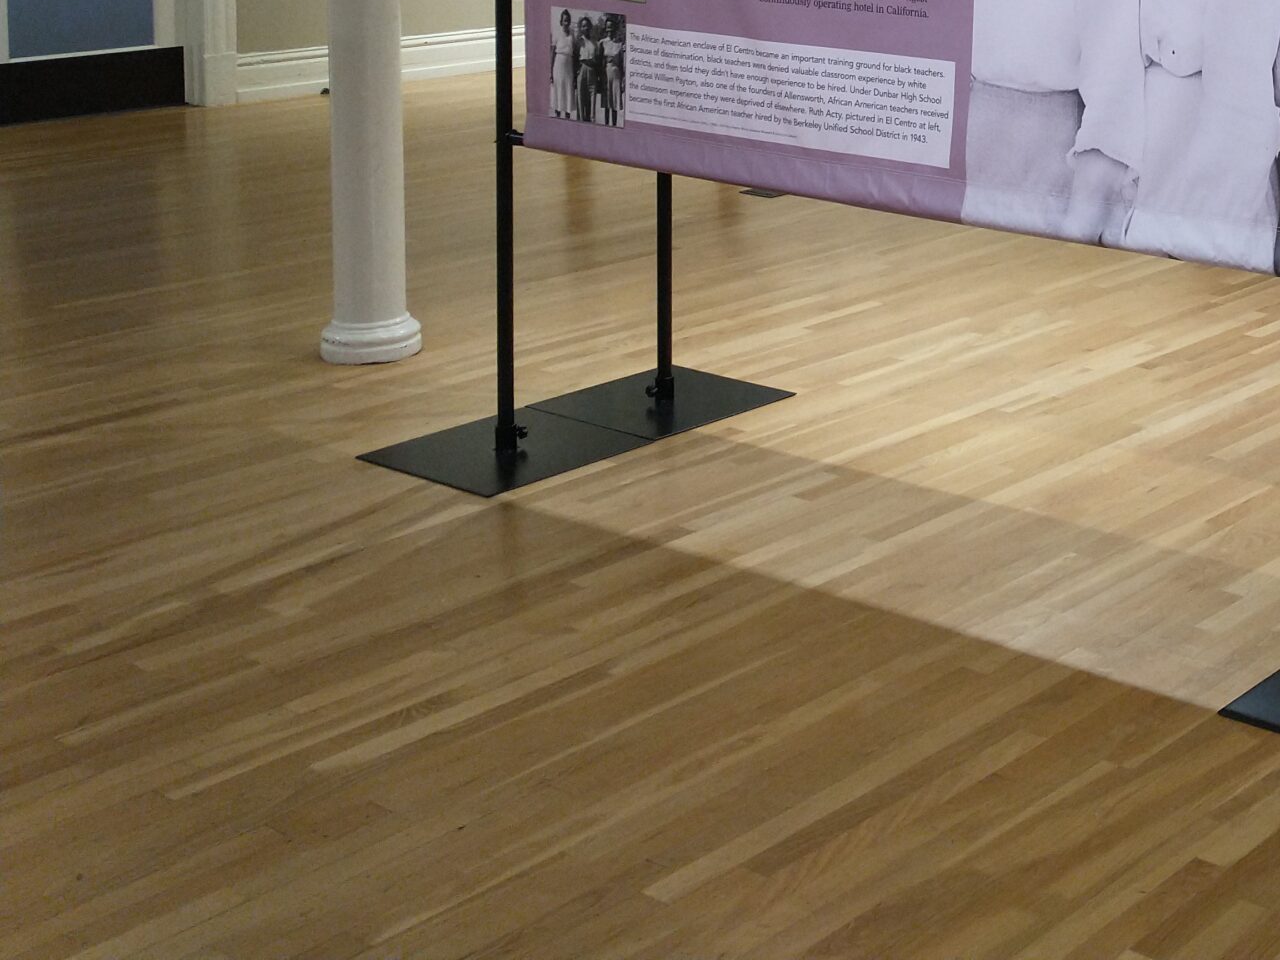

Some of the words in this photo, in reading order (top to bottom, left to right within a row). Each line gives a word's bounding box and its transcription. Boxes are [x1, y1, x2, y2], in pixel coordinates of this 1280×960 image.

[813, 0, 852, 12] operating
[854, 1, 874, 12] hotel
[876, 4, 884, 13] in
[886, 5, 929, 18] California.
[793, 119, 822, 131] Berkeley
[823, 122, 848, 132] Unified
[850, 125, 873, 135] School
[876, 128, 900, 139] District
[902, 132, 907, 140] in
[910, 133, 927, 143] 1943.
